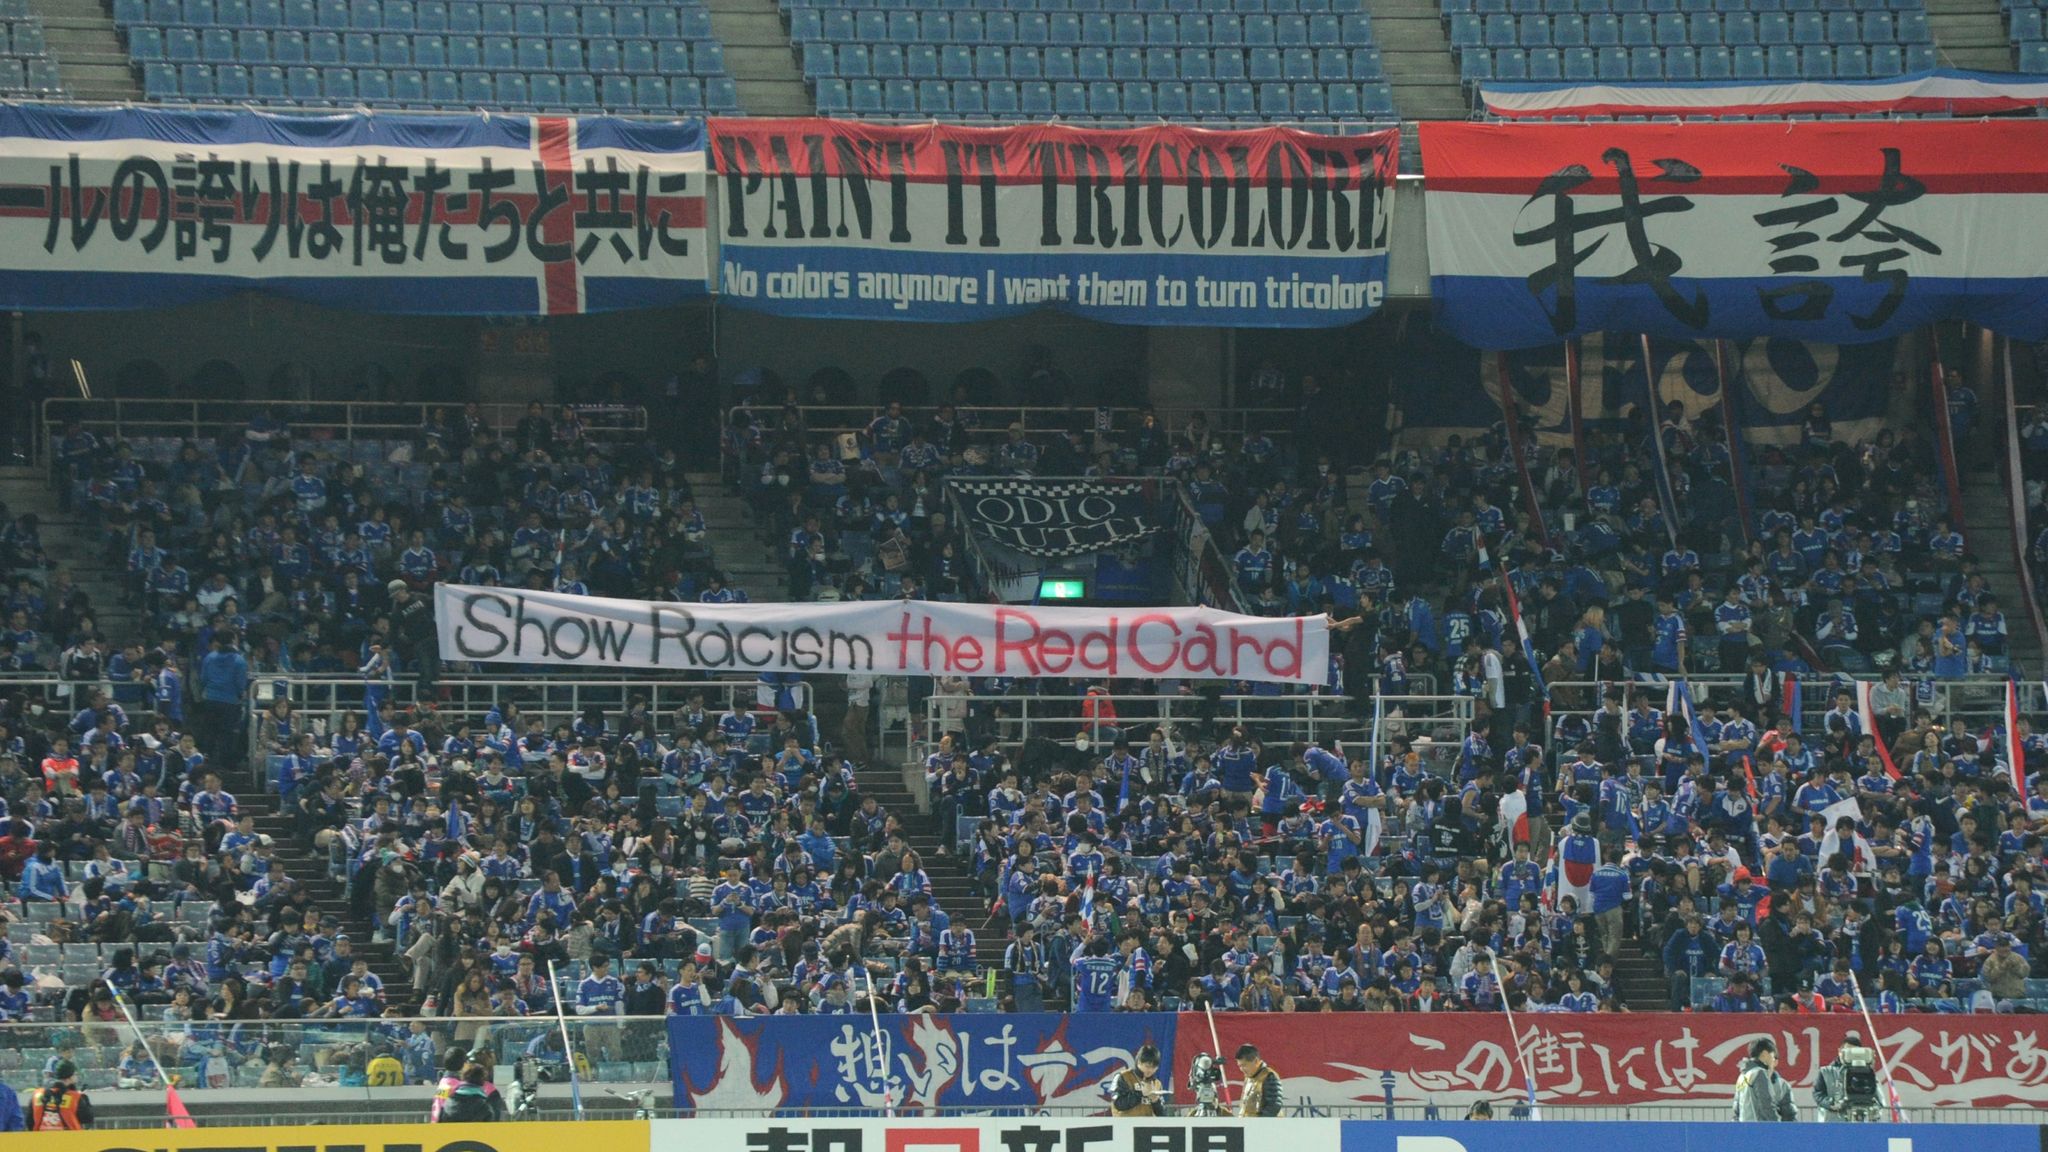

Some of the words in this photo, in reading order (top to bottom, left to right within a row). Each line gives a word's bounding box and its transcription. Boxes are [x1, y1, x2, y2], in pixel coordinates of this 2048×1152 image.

[717, 134, 916, 244] PAINT
[939, 139, 1007, 247] IT
[1027, 139, 1389, 253] TRICOLORE
[723, 260, 758, 298] No
[766, 263, 850, 299] colors
[857, 271, 979, 311] anymore
[986, 269, 996, 306] I
[1003, 273, 1072, 306] want
[1077, 271, 1148, 307] them
[1155, 274, 1188, 307] to
[1195, 275, 1257, 308] turn
[1264, 272, 1384, 310] tricolore
[976, 495, 1117, 525] ODIO
[455, 592, 634, 663] Show
[650, 604, 874, 671] Racism
[887, 611, 984, 673] the
[994, 608, 1118, 676] Red
[1127, 613, 1303, 680] Card
[1450, 619, 1470, 640] 25
[1089, 972, 1109, 995] 12
